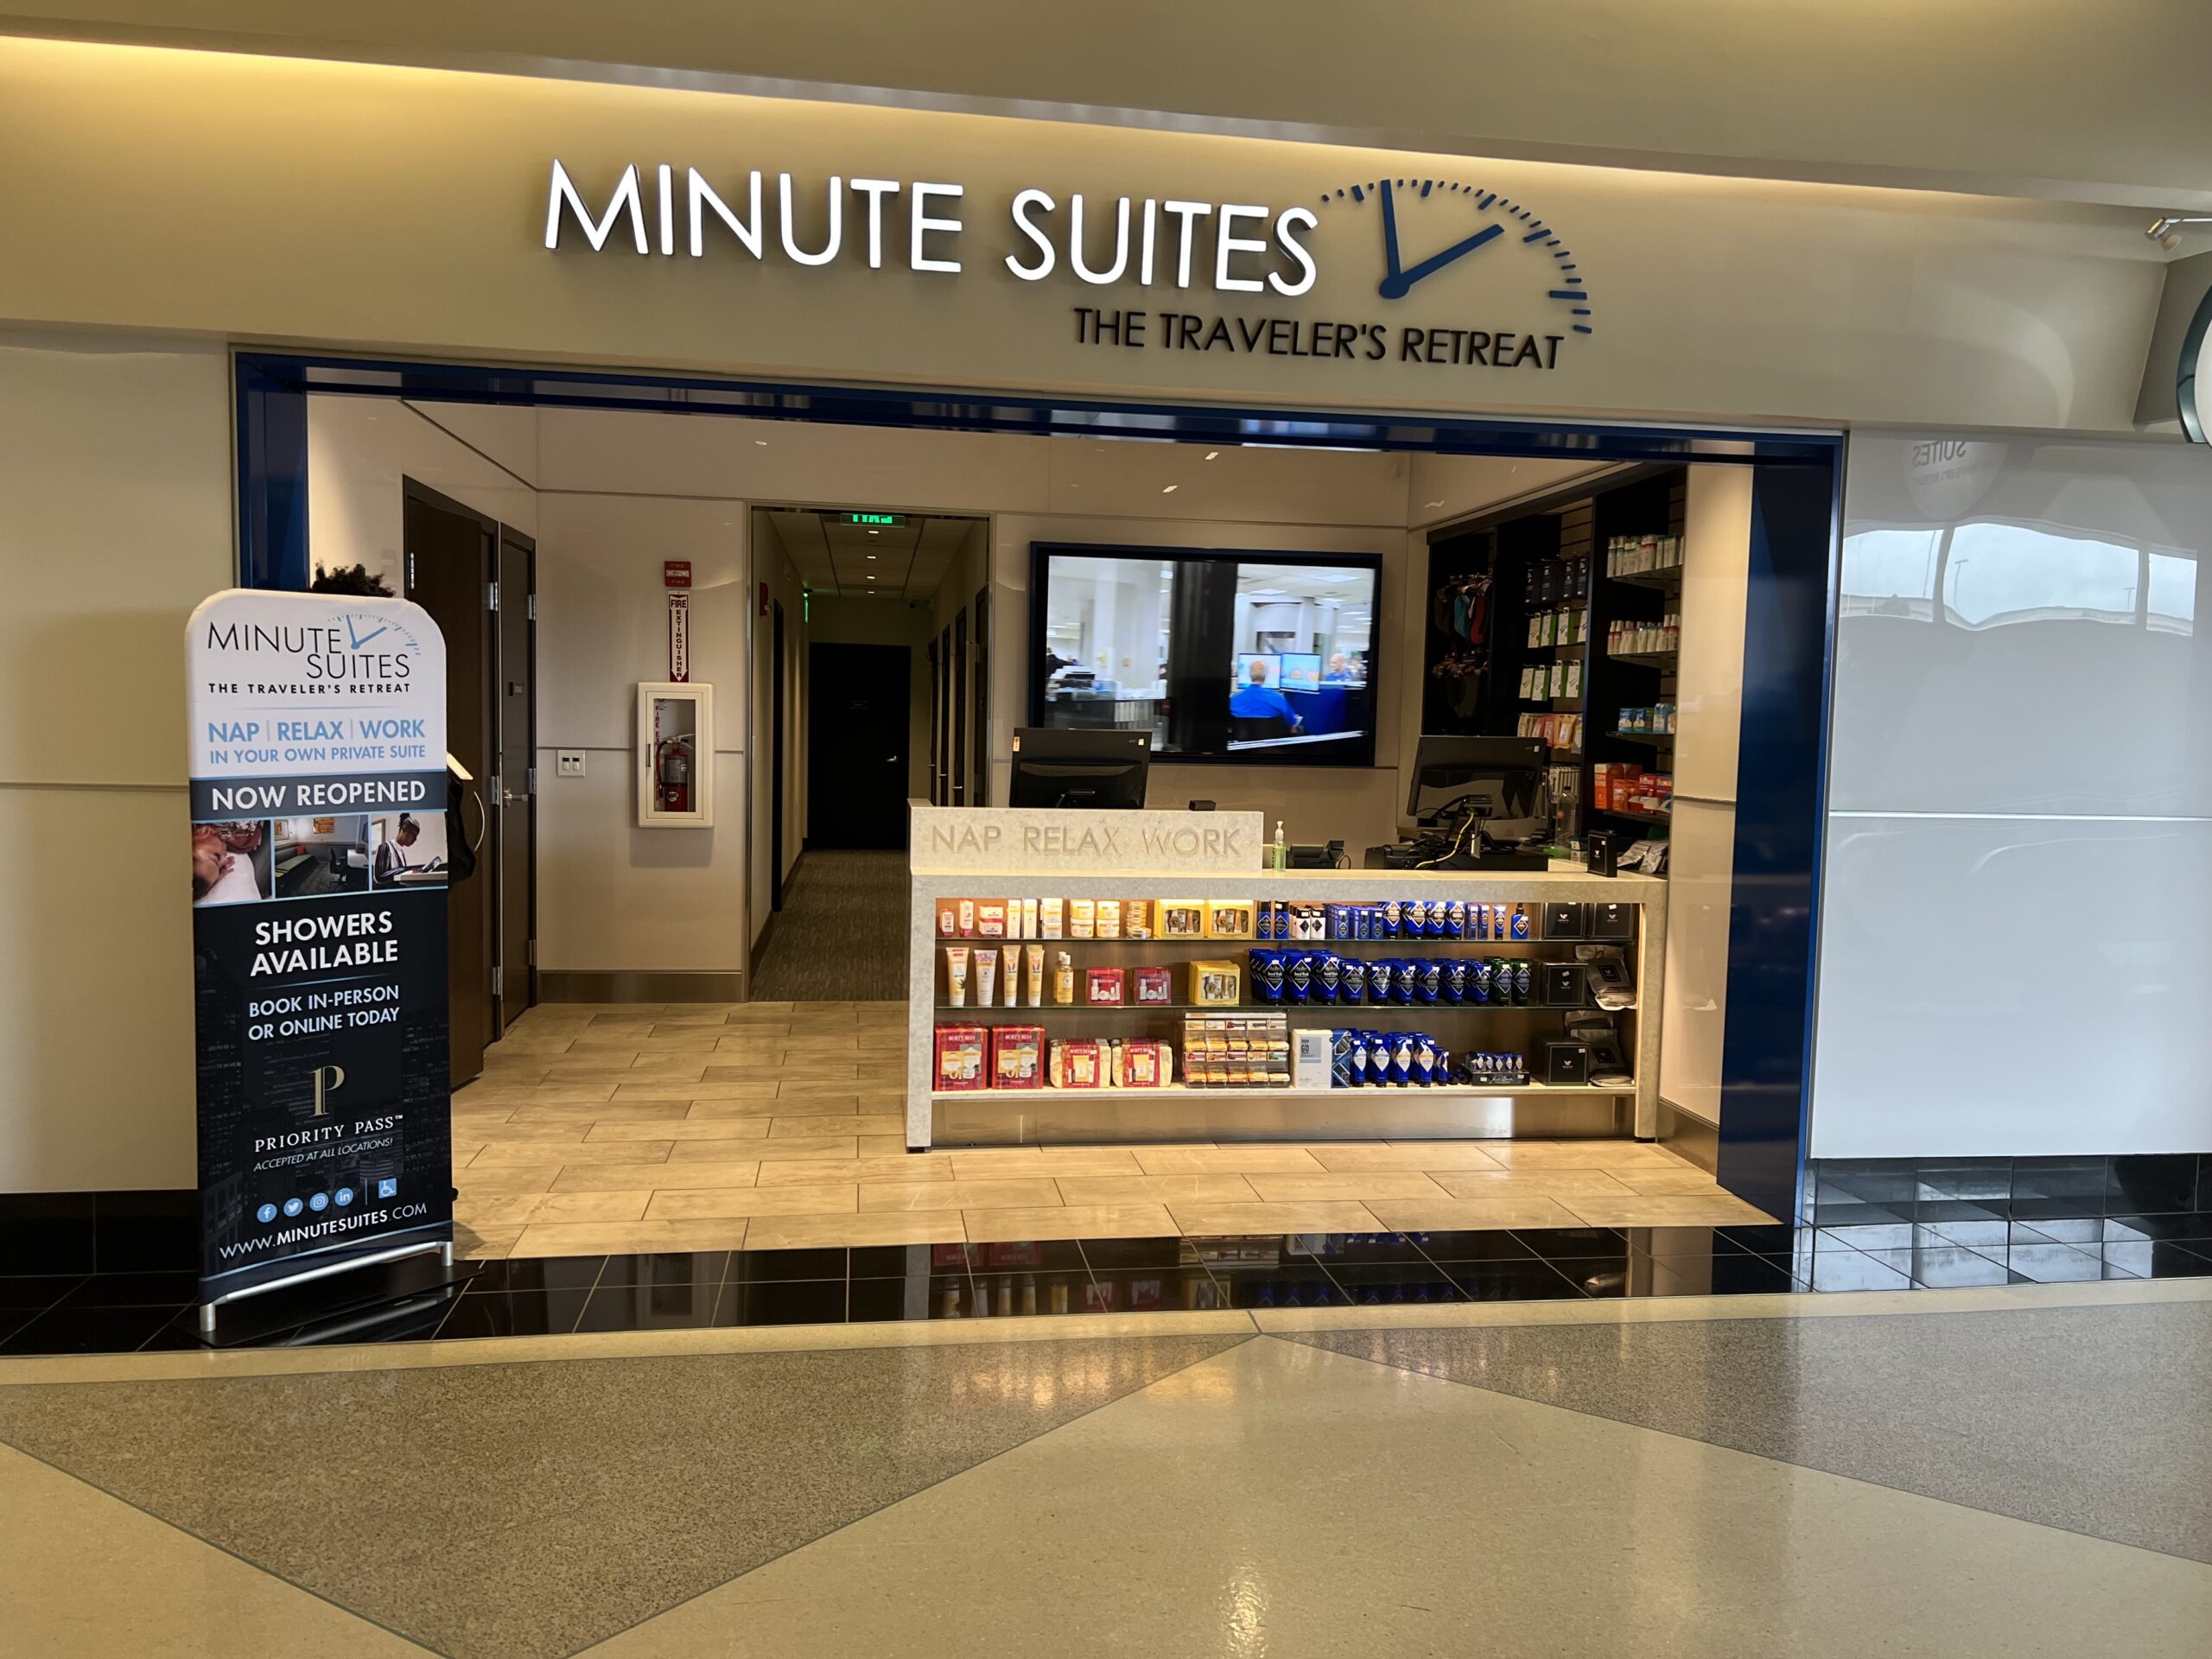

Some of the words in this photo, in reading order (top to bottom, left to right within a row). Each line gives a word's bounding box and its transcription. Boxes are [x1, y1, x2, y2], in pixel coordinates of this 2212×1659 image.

[544, 159, 963, 273] MINUTE
[1005, 189, 1319, 296] SUITES
[1073, 307, 1146, 348] THE
[1159, 313, 1387, 362] TRAVELER'S
[1398, 327, 1566, 371] RETREAT
[671, 600, 687, 608] FIRE
[208, 622, 342, 654] MINUTE
[306, 653, 410, 679] SUITES
[209, 683, 238, 693] THE
[248, 683, 340, 694] TRAVELER'S
[350, 683, 410, 693] RETREAT
[208, 721, 260, 743] NAP
[276, 721, 345, 741] RELAX
[359, 719, 426, 740] WORK
[210, 750, 228, 765] IN
[233, 748, 279, 764] YOUR
[284, 747, 327, 761] OWN
[331, 746, 385, 760] PRIVATE
[390, 745, 426, 759] SUITE
[212, 785, 287, 810] NOW
[296, 780, 426, 806] REOPENED
[931, 824, 1002, 852] NAP
[1022, 826, 1121, 856] RELAX
[1141, 828, 1242, 857] WORK
[255, 911, 393, 946] SHOWERS
[250, 939, 398, 977] AVAILABLE
[249, 996, 302, 1018] BOOK
[308, 985, 399, 1010] IN-PERSON
[248, 1025, 275, 1041] OR
[279, 1015, 343, 1037] ONLINE
[346, 1007, 400, 1027] TODAY
[253, 1154, 305, 1172] ACCEPTED
[306, 1150, 320, 1161] AT
[320, 1147, 336, 1159] ALL
[338, 1137, 393, 1155] LOCATIONS!
[255, 1124, 346, 1153] PRIORITY
[219, 1202, 427, 1259] WWW.MINUTESUITES.COM
